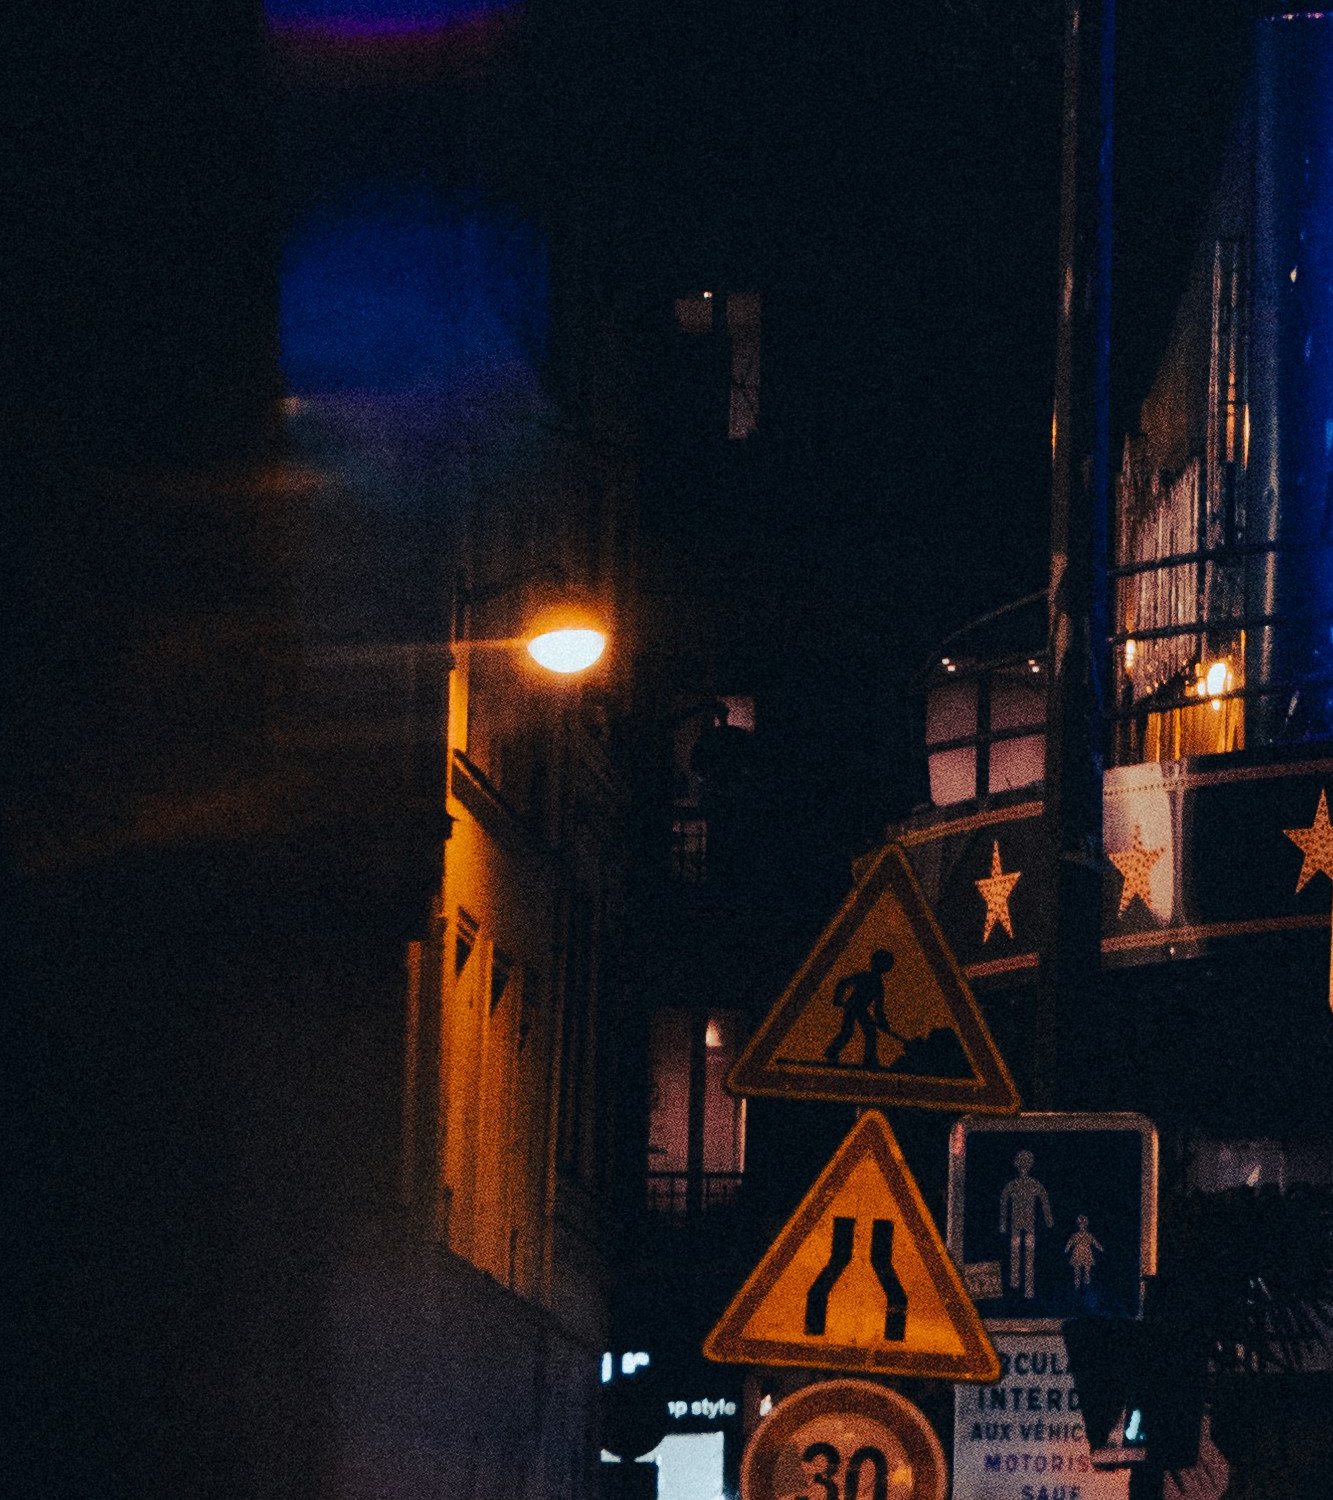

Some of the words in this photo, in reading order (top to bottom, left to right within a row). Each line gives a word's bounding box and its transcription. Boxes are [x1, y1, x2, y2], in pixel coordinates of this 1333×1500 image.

[691, 1397, 738, 1420] style
[979, 1387, 1083, 1411] INTERD
[971, 1423, 1012, 1442] AUX
[1020, 1418, 1087, 1442] VÉHIC
[984, 1454, 1091, 1474] MOTORIS
